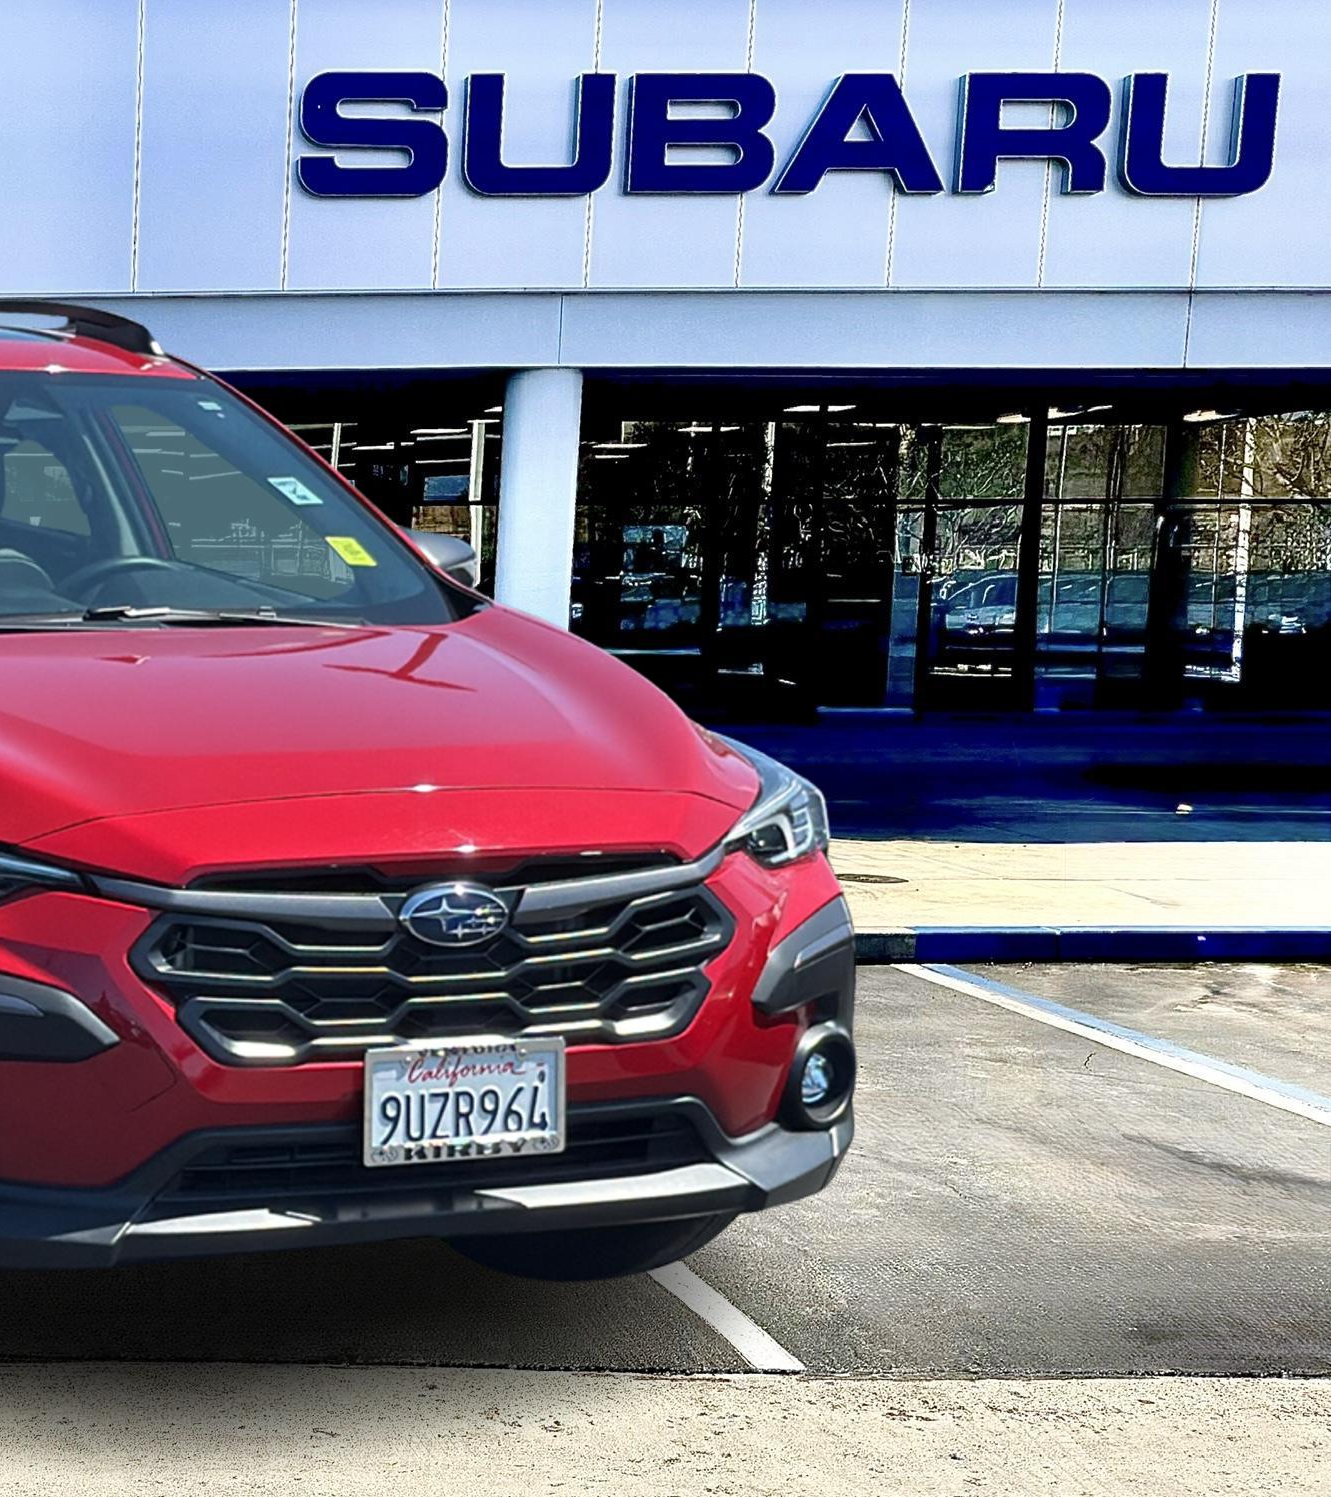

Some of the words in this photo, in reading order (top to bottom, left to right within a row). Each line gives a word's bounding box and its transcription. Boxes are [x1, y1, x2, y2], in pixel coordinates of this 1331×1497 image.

[296, 71, 1280, 197] SUBARU
[408, 1055, 526, 1087] California
[380, 1085, 548, 1145] 9UZR964
